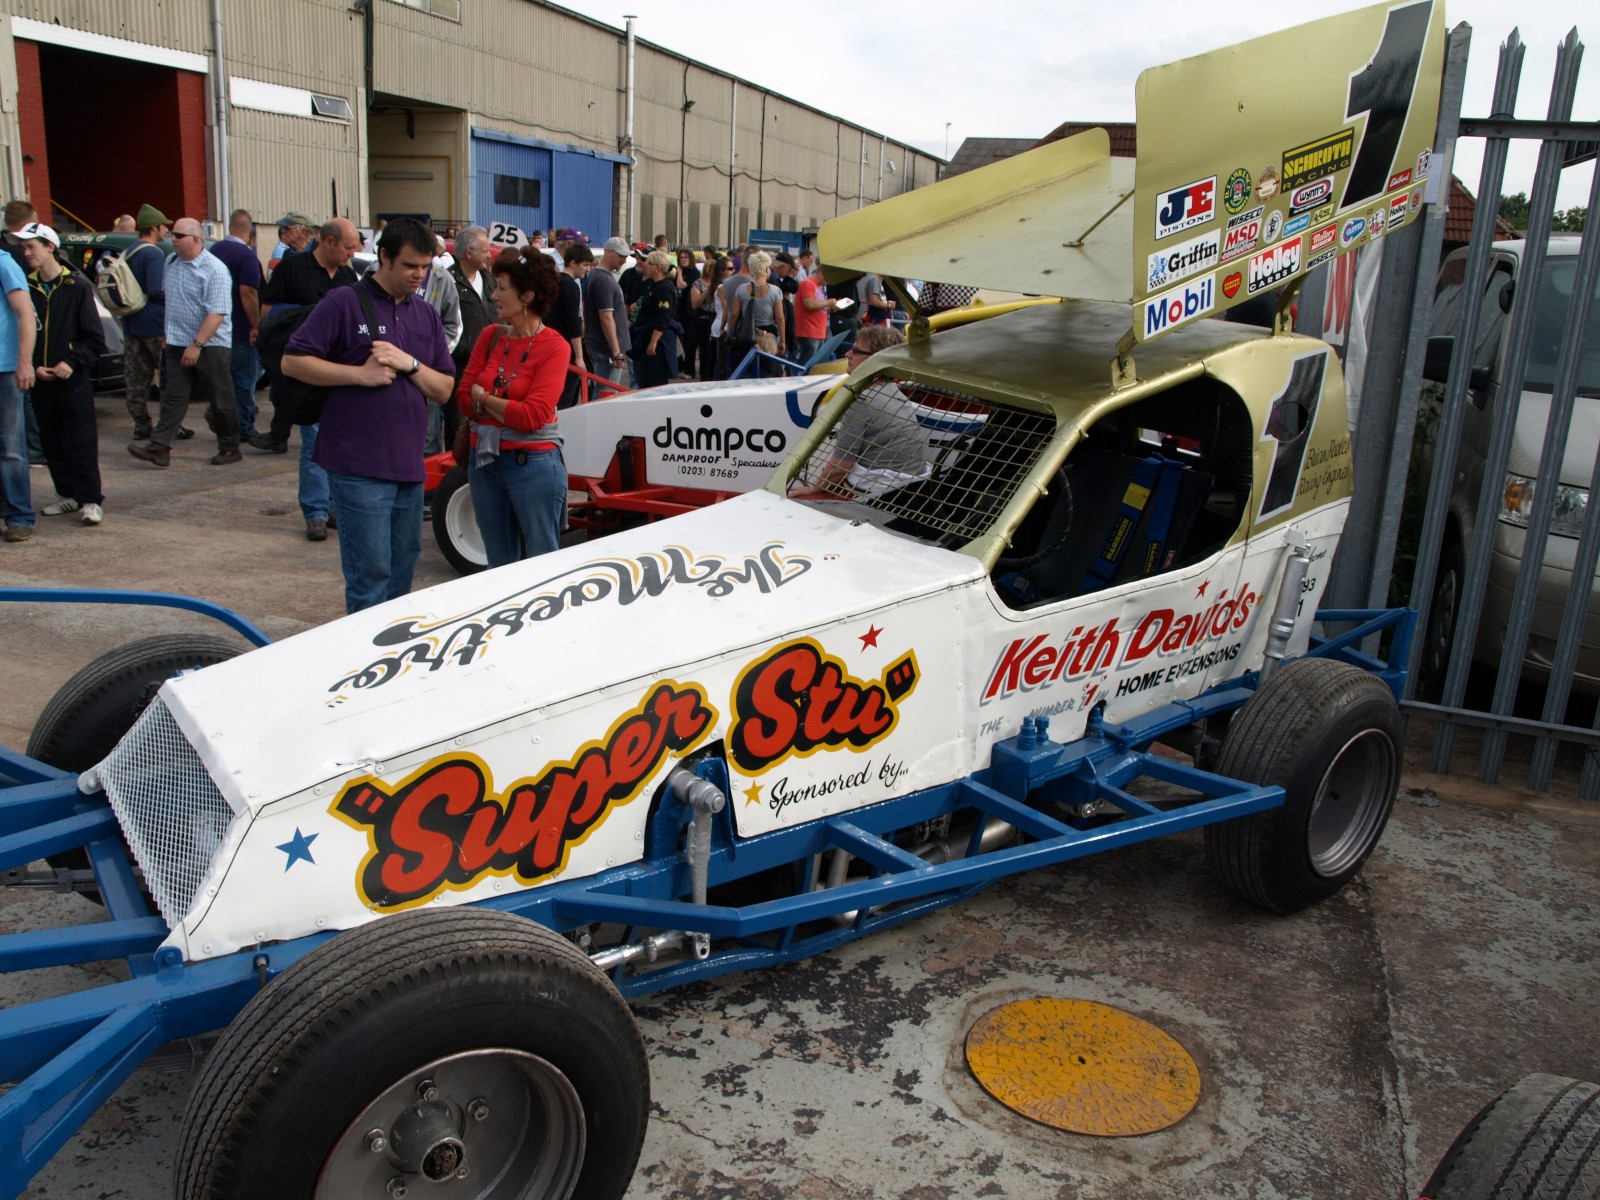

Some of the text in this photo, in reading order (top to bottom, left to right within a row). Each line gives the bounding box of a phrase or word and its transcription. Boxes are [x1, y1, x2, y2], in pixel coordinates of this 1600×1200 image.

[1335, 0, 1434, 214] 1
[1284, 138, 1352, 179] SCHROTH
[1283, 160, 1350, 190] RACING
[1160, 180, 1213, 226] JE
[1227, 206, 1264, 229] WISECO
[492, 224, 519, 245] 25
[1159, 213, 1212, 236] PISTONS
[1225, 222, 1258, 251] MSD
[1168, 240, 1218, 272] Griffin
[1169, 256, 1217, 281] RADIATOR
[1250, 243, 1301, 283] Holley
[1307, 248, 1336, 270] WISECO
[1249, 268, 1288, 291] CARBS
[1147, 278, 1212, 334] Mobil
[653, 417, 787, 459] dampco
[661, 453, 722, 464] DAMPROOF
[677, 465, 739, 479] (0203) 87689
[981, 582, 1257, 704] Keith Davids
[1115, 643, 1241, 698] HOME EXTENSIONS
[980, 716, 1005, 737] THE
[1028, 697, 1076, 719] NUMBER
[769, 759, 873, 818] Sponsored
